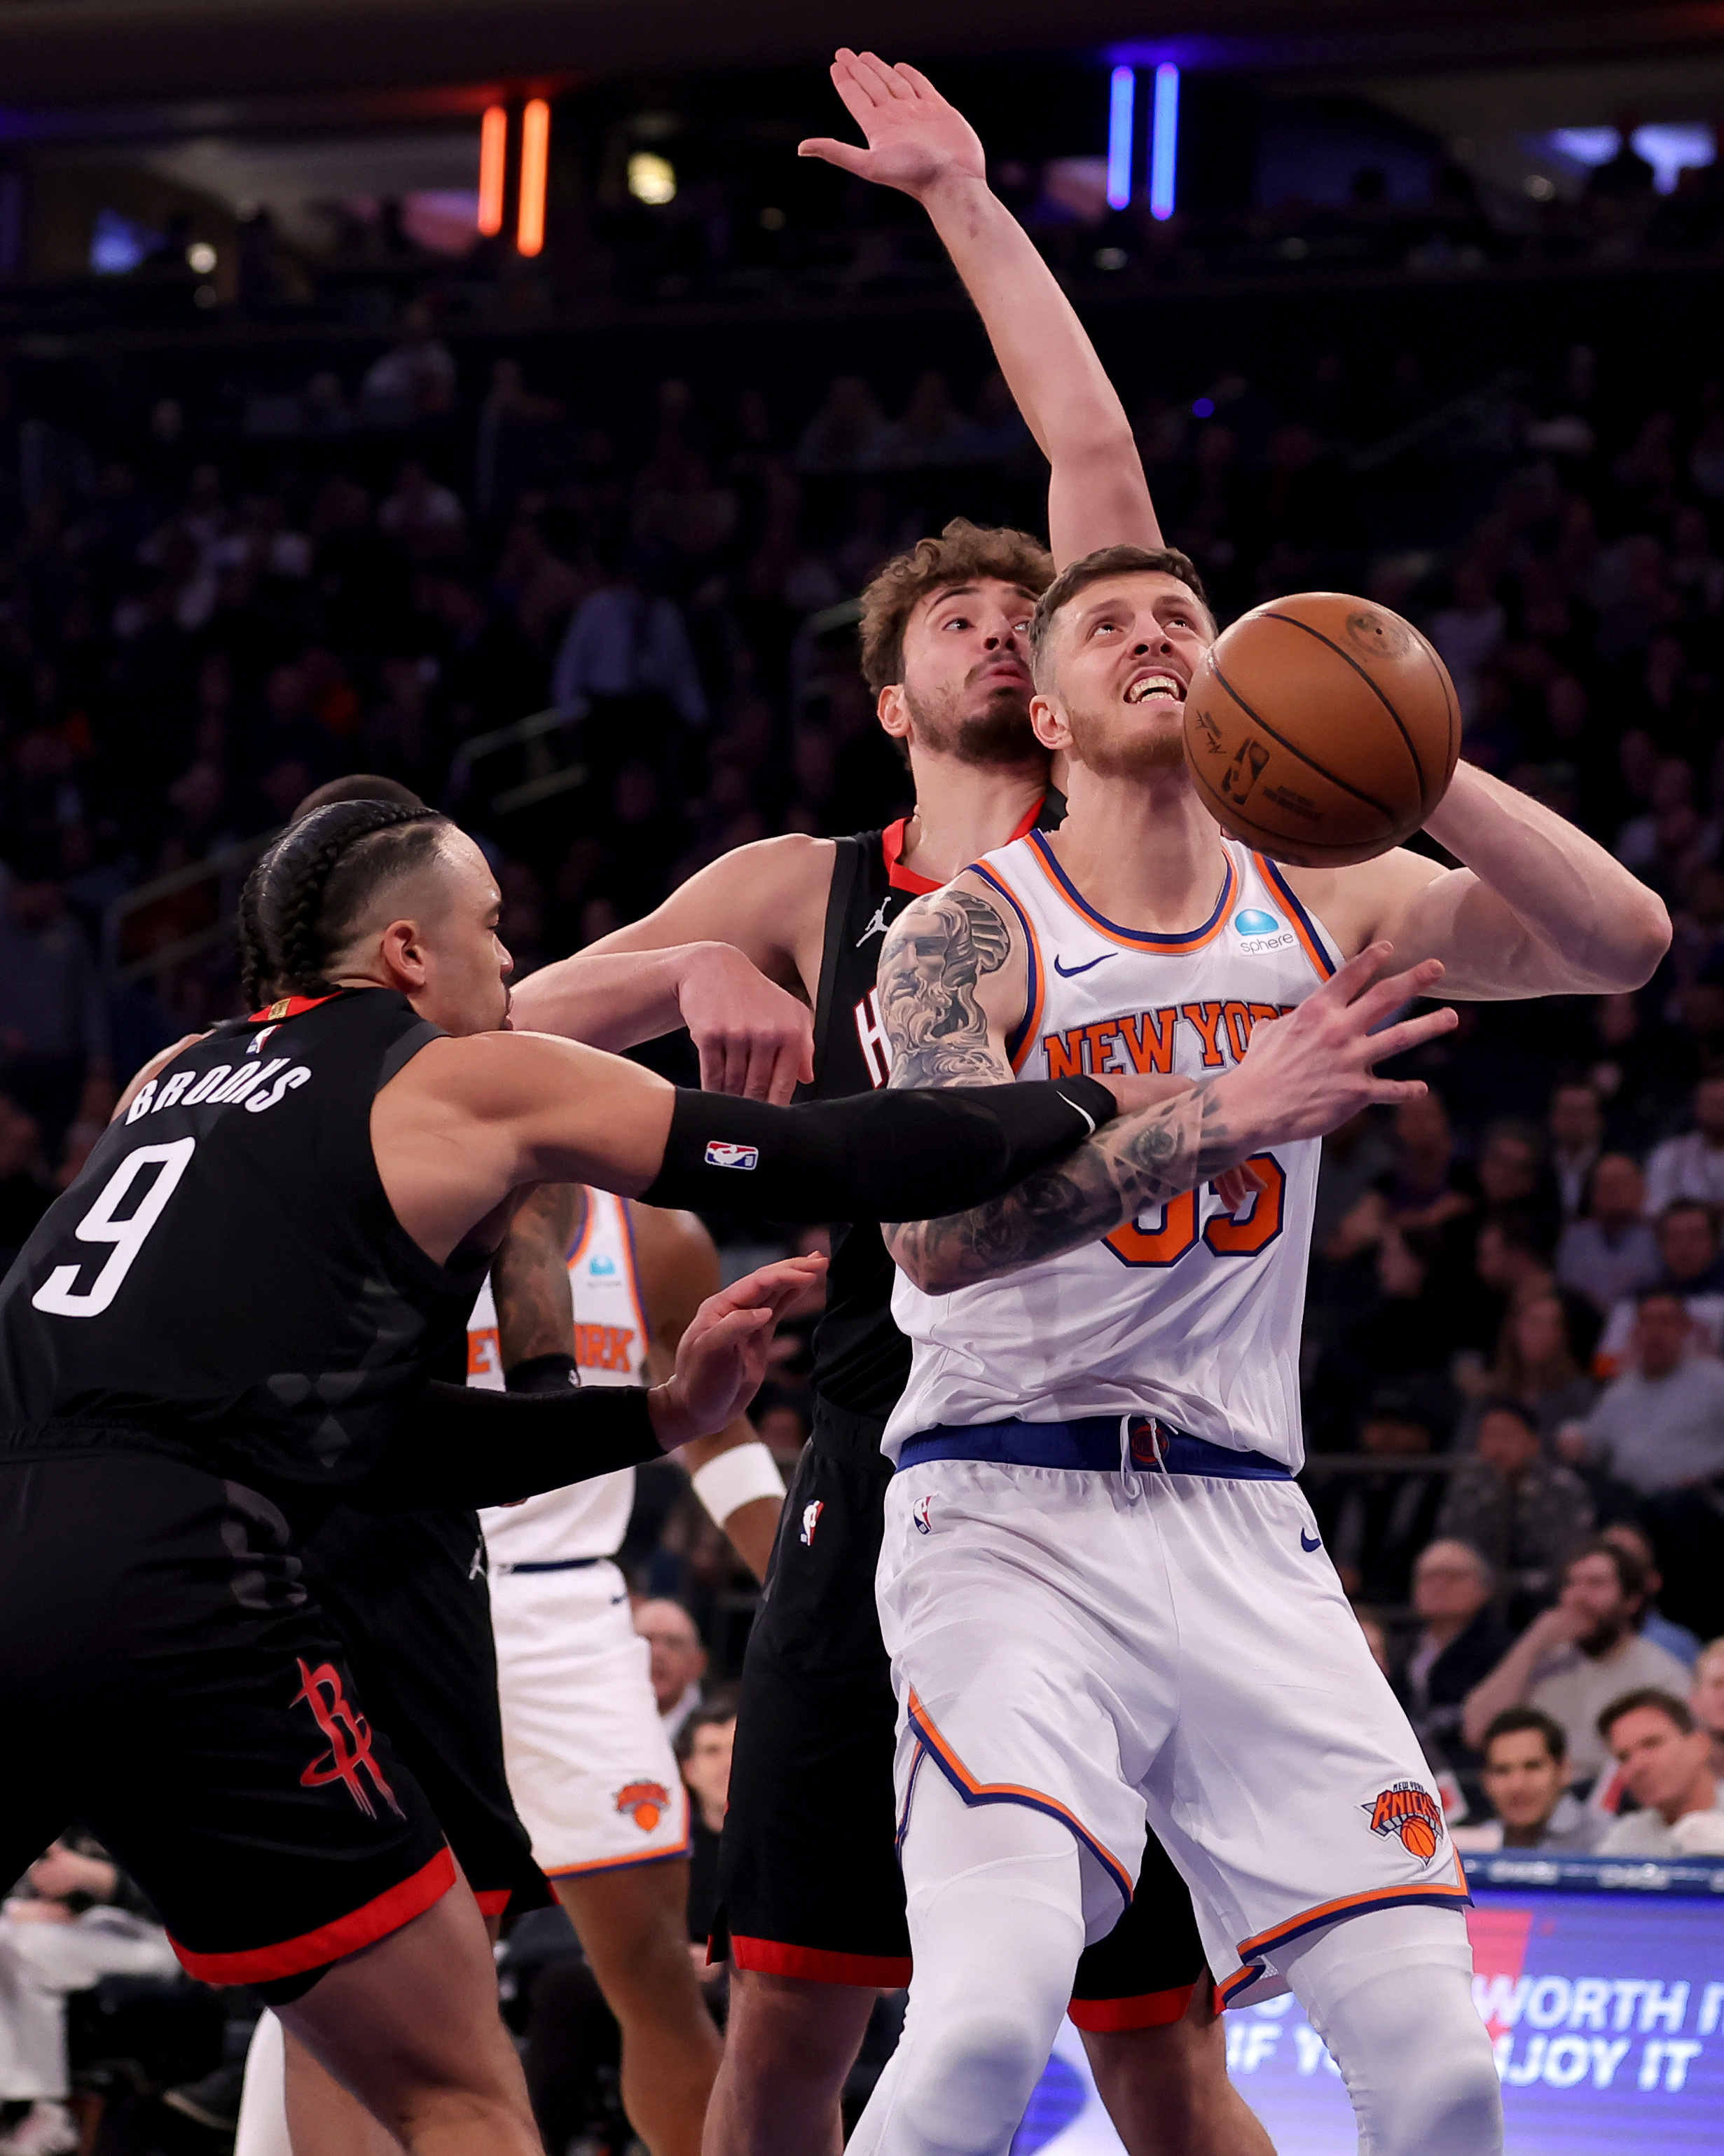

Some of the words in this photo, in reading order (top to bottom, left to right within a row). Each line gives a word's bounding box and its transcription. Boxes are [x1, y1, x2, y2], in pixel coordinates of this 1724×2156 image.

[1240, 933, 1294, 954] sphere
[1042, 1004, 1178, 1080] NEW
[1181, 1000, 1298, 1069] YO
[124, 1057, 312, 1126] BROOKS
[31, 1135, 196, 1318] 9
[574, 1323, 635, 1373] RK
[1370, 1789, 1443, 1832] KNICKS
[1393, 1780, 1408, 1792] NEW
[1471, 1974, 1691, 2033] WORTH
[1226, 2021, 1285, 2075] IF
[1492, 2032, 1632, 2089] JOY
[1636, 2037, 1704, 2094] IT
